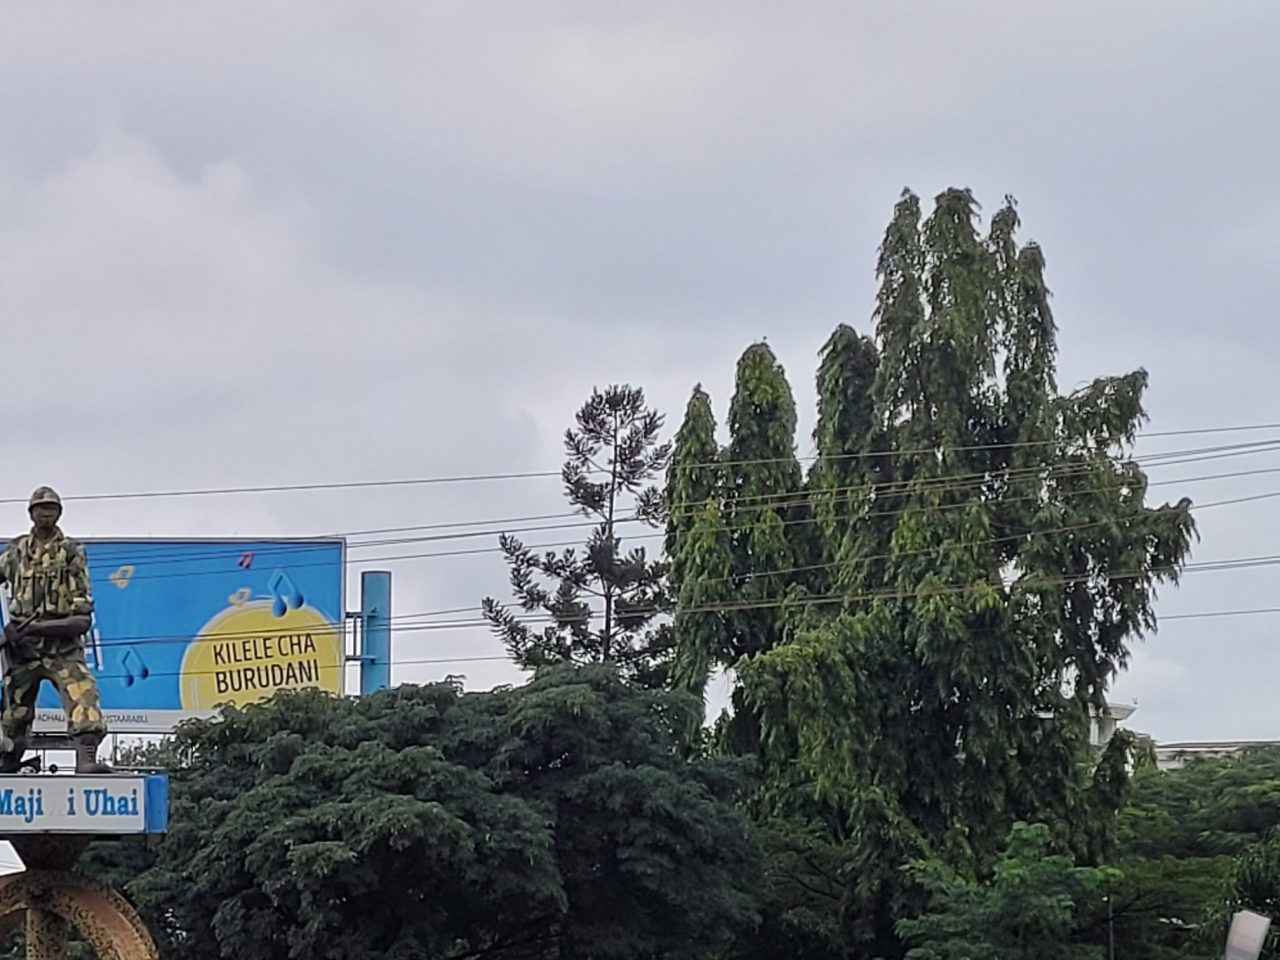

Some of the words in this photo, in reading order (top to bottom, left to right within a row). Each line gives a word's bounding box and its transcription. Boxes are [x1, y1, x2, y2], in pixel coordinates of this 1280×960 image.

[213, 637, 274, 665] KILELE
[277, 633, 317, 656] CHA
[215, 659, 319, 694] BURUDANI
[83, 788, 139, 816] Uhai
